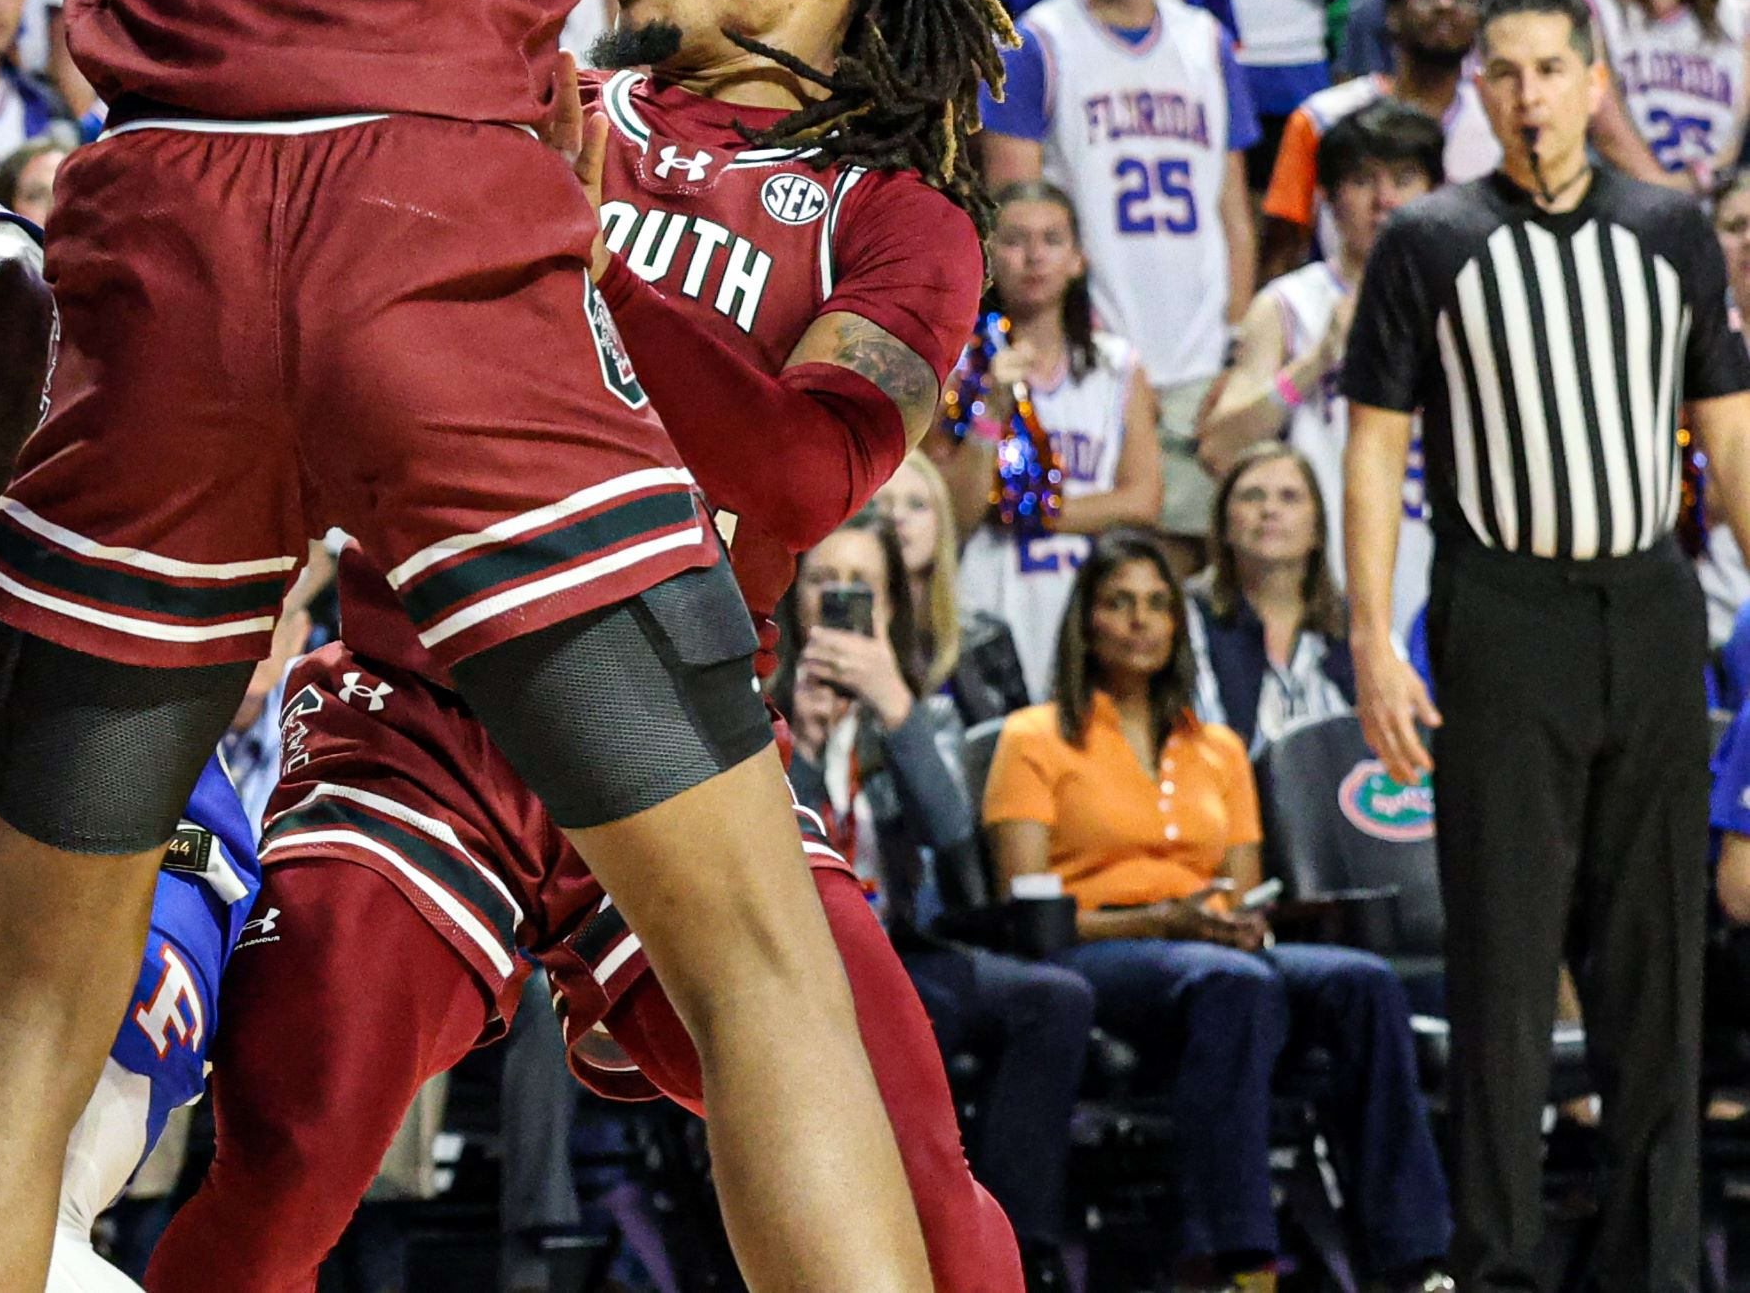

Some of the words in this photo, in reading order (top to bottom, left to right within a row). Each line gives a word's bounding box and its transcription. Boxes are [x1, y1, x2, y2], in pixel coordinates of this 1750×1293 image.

[1086, 90, 1210, 146] FLORIDA
[767, 174, 827, 221] SEC
[1116, 159, 1197, 233] 25
[600, 200, 772, 333] OUTH
[169, 839, 190, 856] 44
[134, 942, 203, 1060] F
